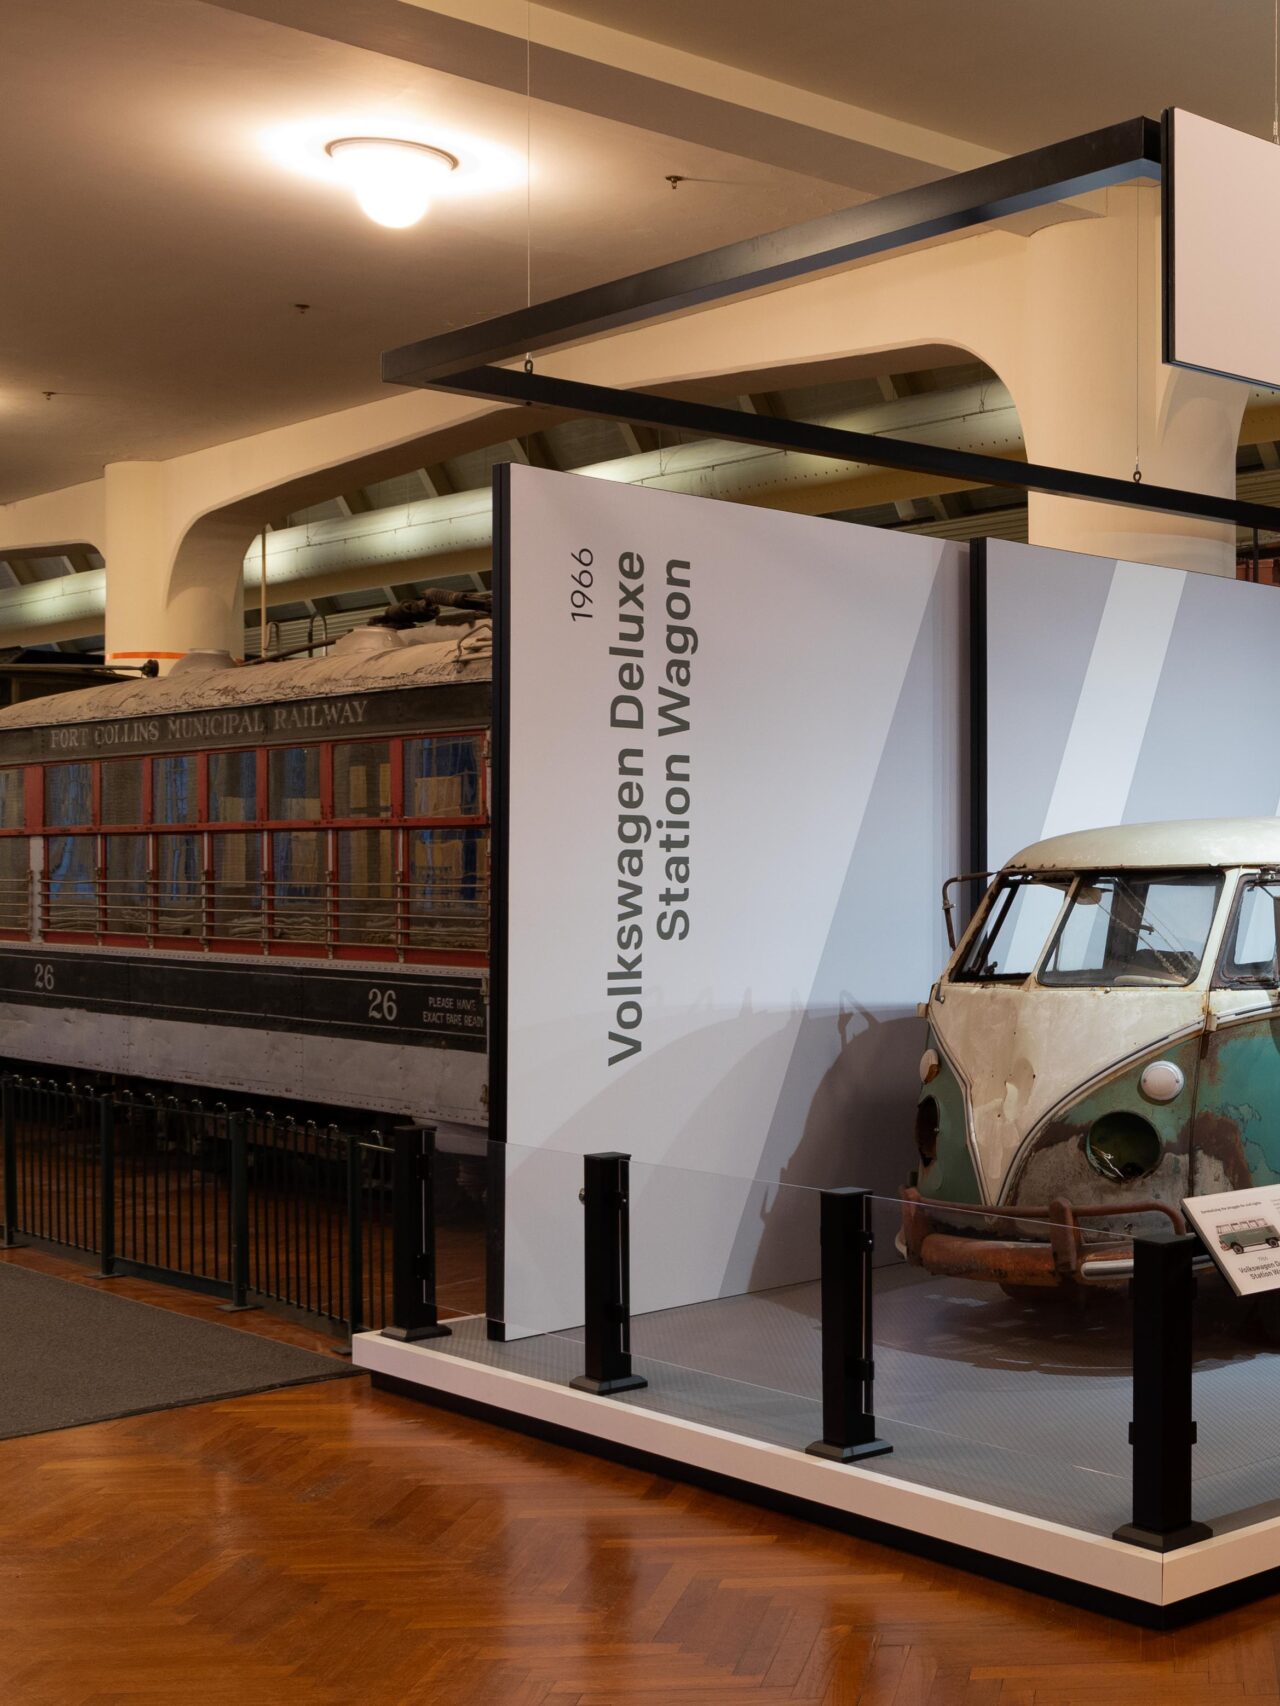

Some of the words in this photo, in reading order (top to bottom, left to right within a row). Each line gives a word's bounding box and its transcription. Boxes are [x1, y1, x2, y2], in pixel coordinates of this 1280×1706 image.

[570, 548, 594, 622] 1966
[609, 551, 645, 730] Deluxe
[658, 559, 699, 737] Wagon
[50, 728, 89, 749] FORT
[94, 720, 160, 745] COLLINS
[167, 710, 265, 740] MUNICIPAL
[273, 700, 369, 730] RAILWAY
[656, 754, 691, 941] Station
[607, 748, 652, 1067] Volkswagen
[34, 963, 55, 990] 26
[368, 988, 398, 1021] 26
[423, 1011, 445, 1024] EXACT
[463, 1015, 485, 1028] READY
[428, 996, 454, 1009] PLEASE
[1238, 1262, 1275, 1273] Volkswagen
[1249, 1271, 1273, 1279] Station
